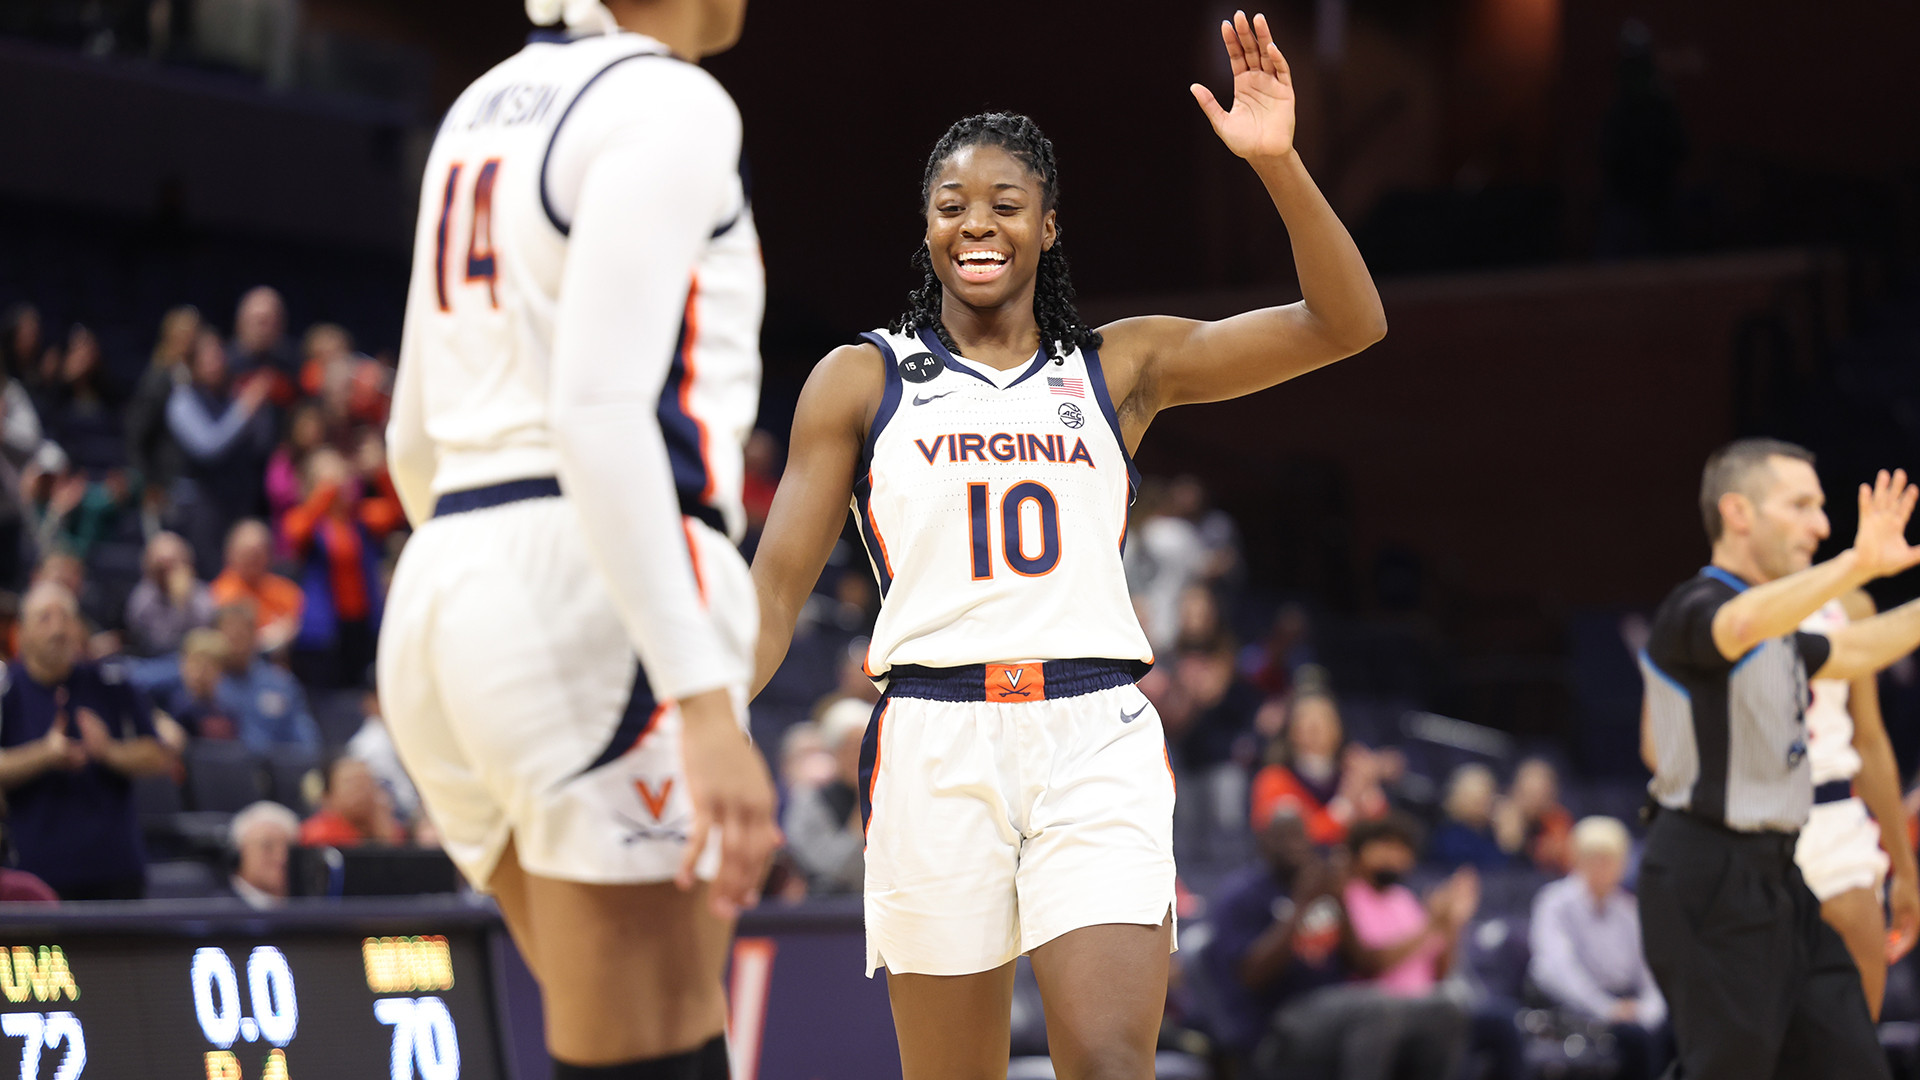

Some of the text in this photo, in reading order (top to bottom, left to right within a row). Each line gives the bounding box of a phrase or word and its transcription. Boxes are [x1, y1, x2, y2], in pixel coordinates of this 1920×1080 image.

[436, 157, 502, 313] 14
[905, 357, 935, 371] 15 41
[1062, 410, 1082, 421] ACC
[914, 433, 1096, 470] VIRGINIA
[967, 480, 1062, 581] 10
[1005, 669, 1023, 689] V
[0, 945, 81, 1002] UVA
[190, 945, 299, 1049] 0.0
[373, 996, 461, 1080] 70
